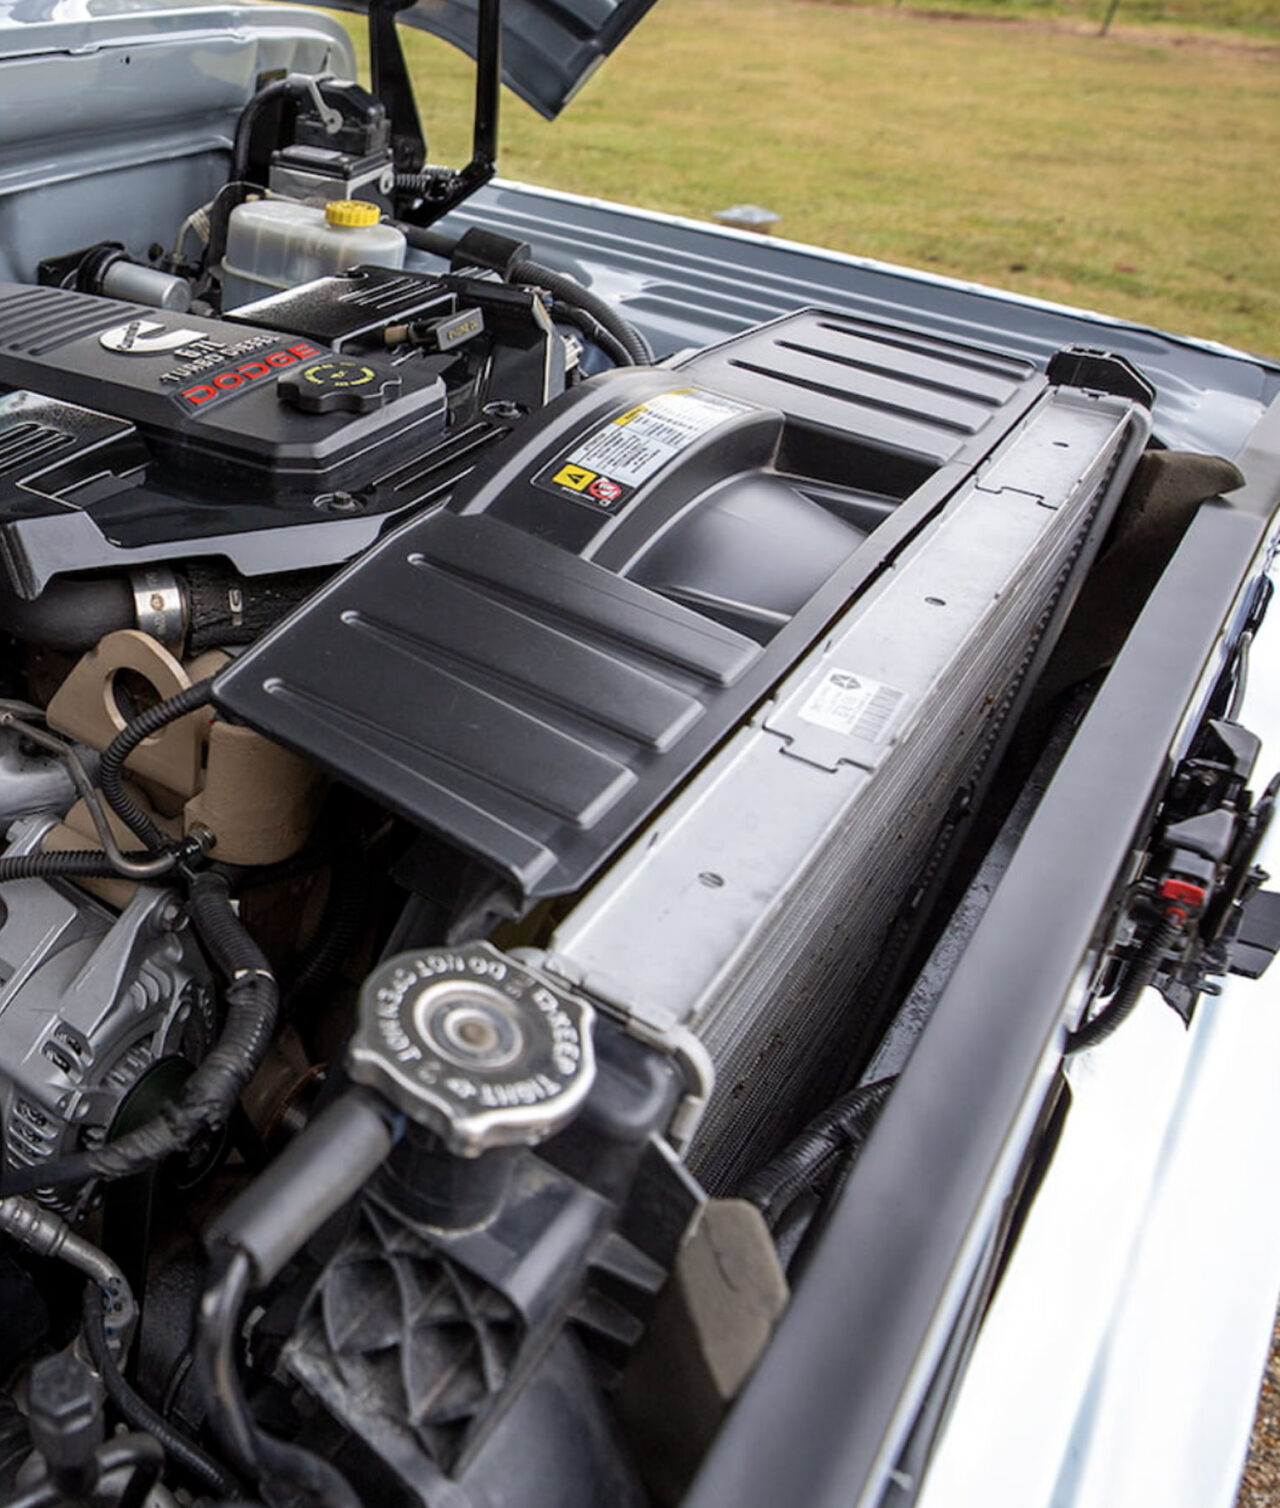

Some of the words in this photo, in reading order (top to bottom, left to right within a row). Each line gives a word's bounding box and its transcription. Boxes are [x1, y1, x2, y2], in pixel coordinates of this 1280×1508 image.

[159, 353, 224, 384] TURBO
[180, 342, 320, 405] DODGE
[415, 954, 466, 978] NOT
[469, 956, 507, 981] DO
